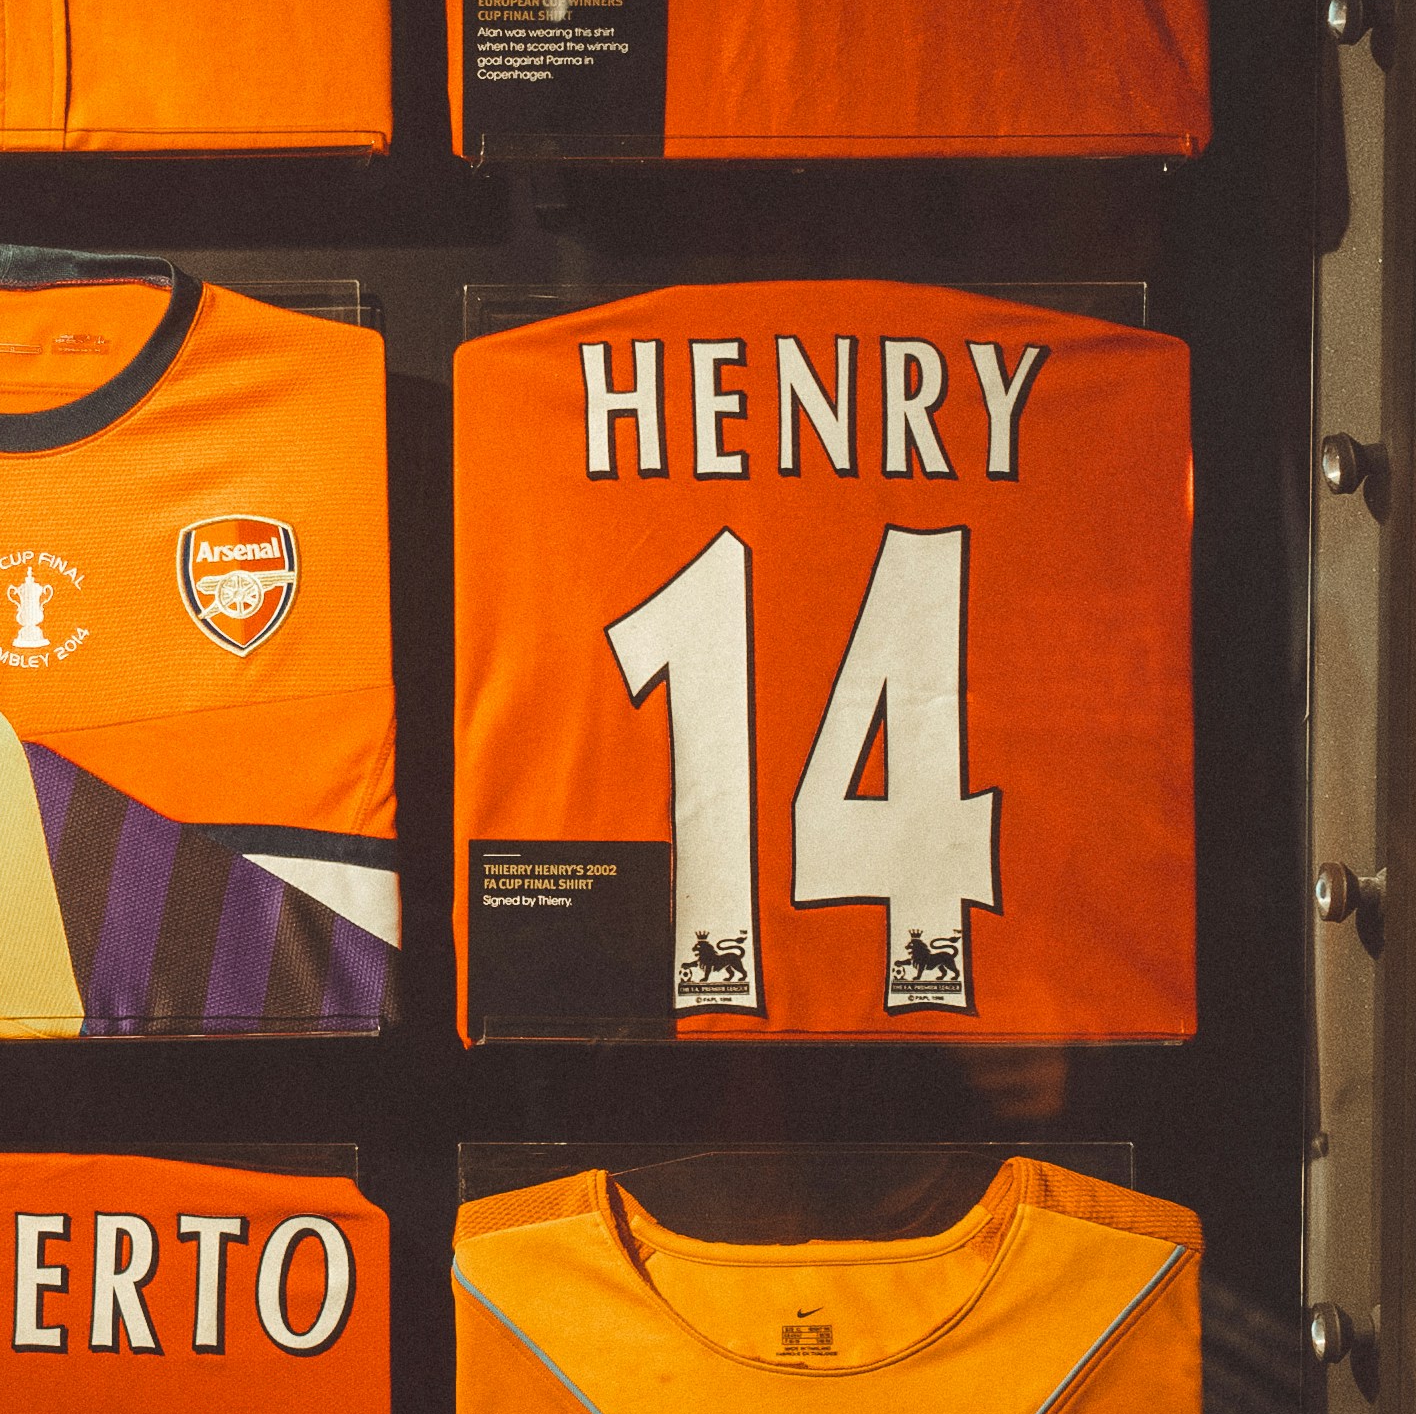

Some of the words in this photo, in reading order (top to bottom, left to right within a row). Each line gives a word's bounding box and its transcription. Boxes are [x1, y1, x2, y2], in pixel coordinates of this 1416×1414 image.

[478, 11, 501, 20] CUP
[504, 11, 534, 20] FINAL
[538, 11, 573, 21] SHIRT
[477, 27, 502, 37] Alan
[505, 29, 526, 37] was
[528, 28, 572, 39] wearing
[575, 28, 592, 37] this
[594, 28, 614, 37] shirt
[477, 42, 508, 51] when
[510, 42, 524, 51] he
[527, 42, 564, 51] scored
[567, 42, 584, 51] the
[587, 42, 628, 53] winning
[477, 56, 502, 67] goal
[505, 56, 544, 67] against
[547, 55, 582, 65] Parma
[584, 56, 593, 64] in
[477, 70, 553, 81] Copenhagen.
[580, 337, 1051, 481] HENRY
[196, 537, 281, 563] Arsenal
[38, 553, 84, 591] FINAL
[54, 628, 89, 660] 2014
[604, 524, 1005, 1018] 14
[484, 865, 532, 875] THIERRY
[535, 865, 584, 875] HENRY'S
[586, 865, 617, 875] 2002
[484, 879, 496, 889] FA
[499, 879, 522, 889] CUP
[524, 879, 556, 889] FINAL
[558, 879, 593, 889] SHIRT
[483, 895, 520, 907] Signed
[522, 895, 536, 907] by
[538, 895, 572, 907] Thierry.
